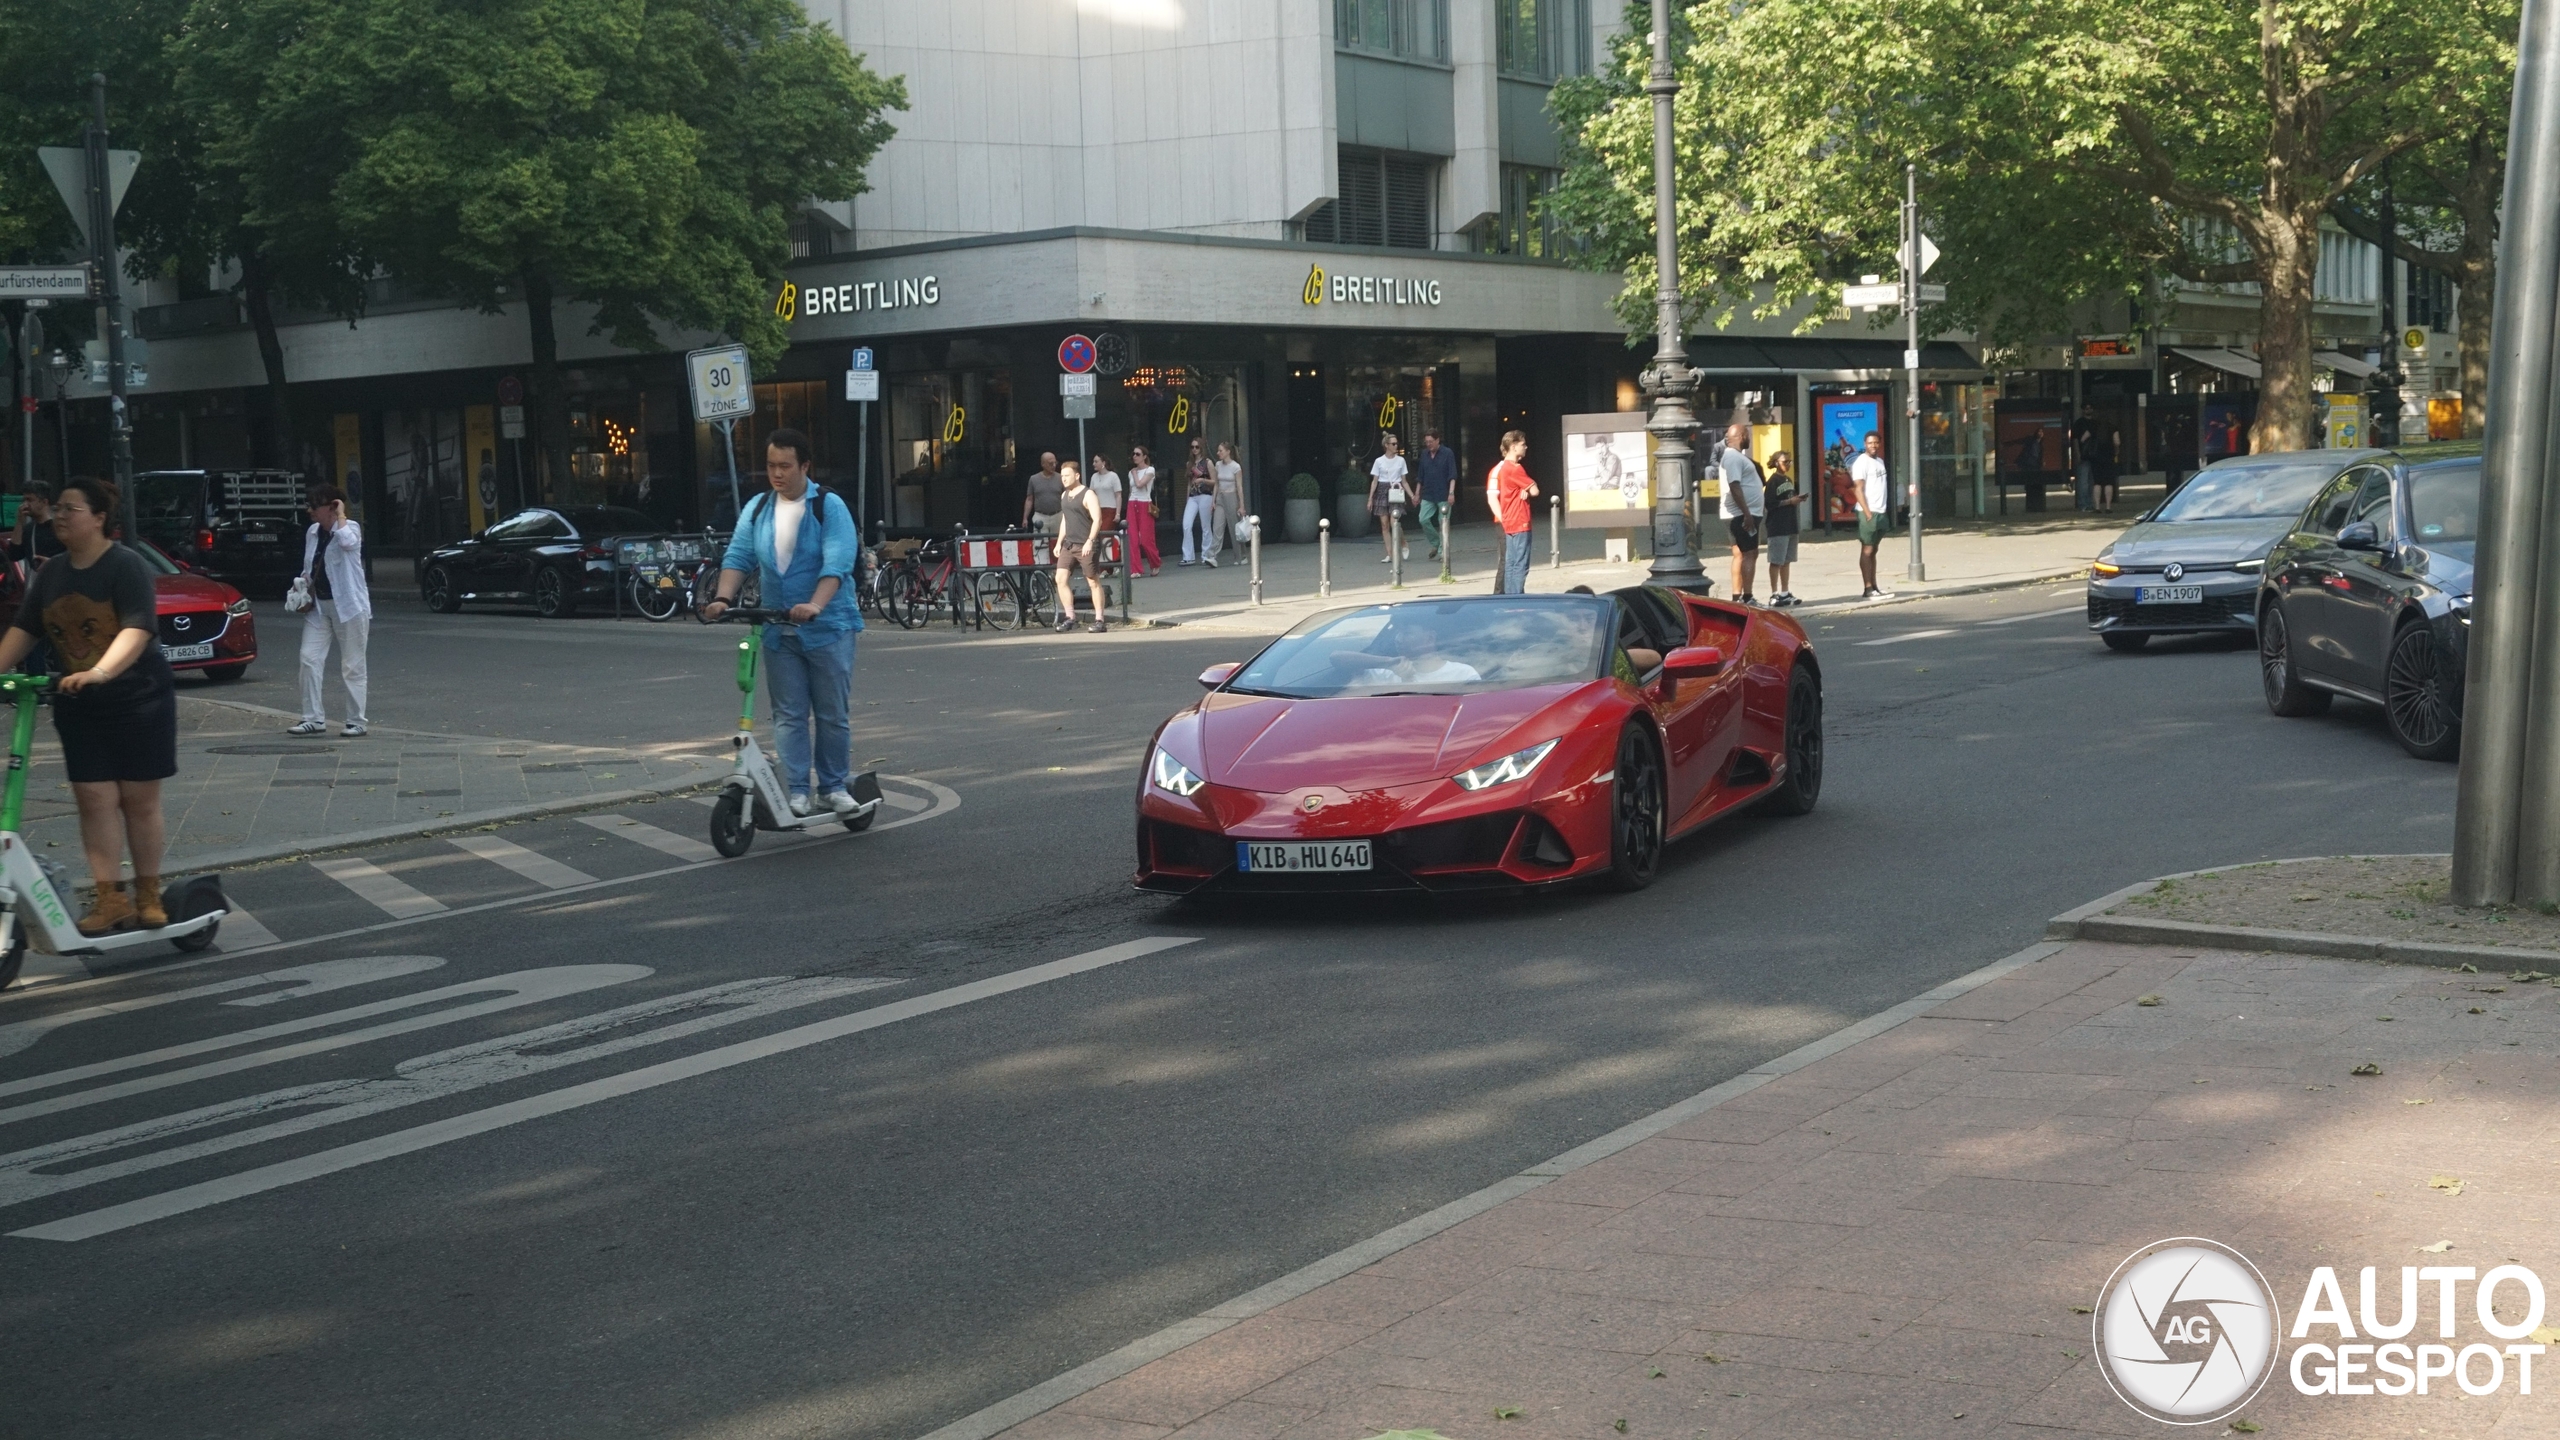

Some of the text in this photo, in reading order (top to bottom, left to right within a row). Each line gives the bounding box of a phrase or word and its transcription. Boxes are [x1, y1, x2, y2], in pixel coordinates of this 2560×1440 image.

[0, 272, 83, 289] urfürstendamm
[1332, 275, 1441, 305] BREITLING
[805, 275, 939, 316] BREITLING
[857, 351, 868, 368] P
[709, 366, 731, 388] 30
[710, 398, 738, 413] ZONE
[2143, 587, 2200, 600] B EN 1907
[177, 646, 197, 657] 6826
[198, 645, 210, 655] CB
[1250, 845, 1369, 868] KIB HU 640
[30, 877, 65, 929] Lime
